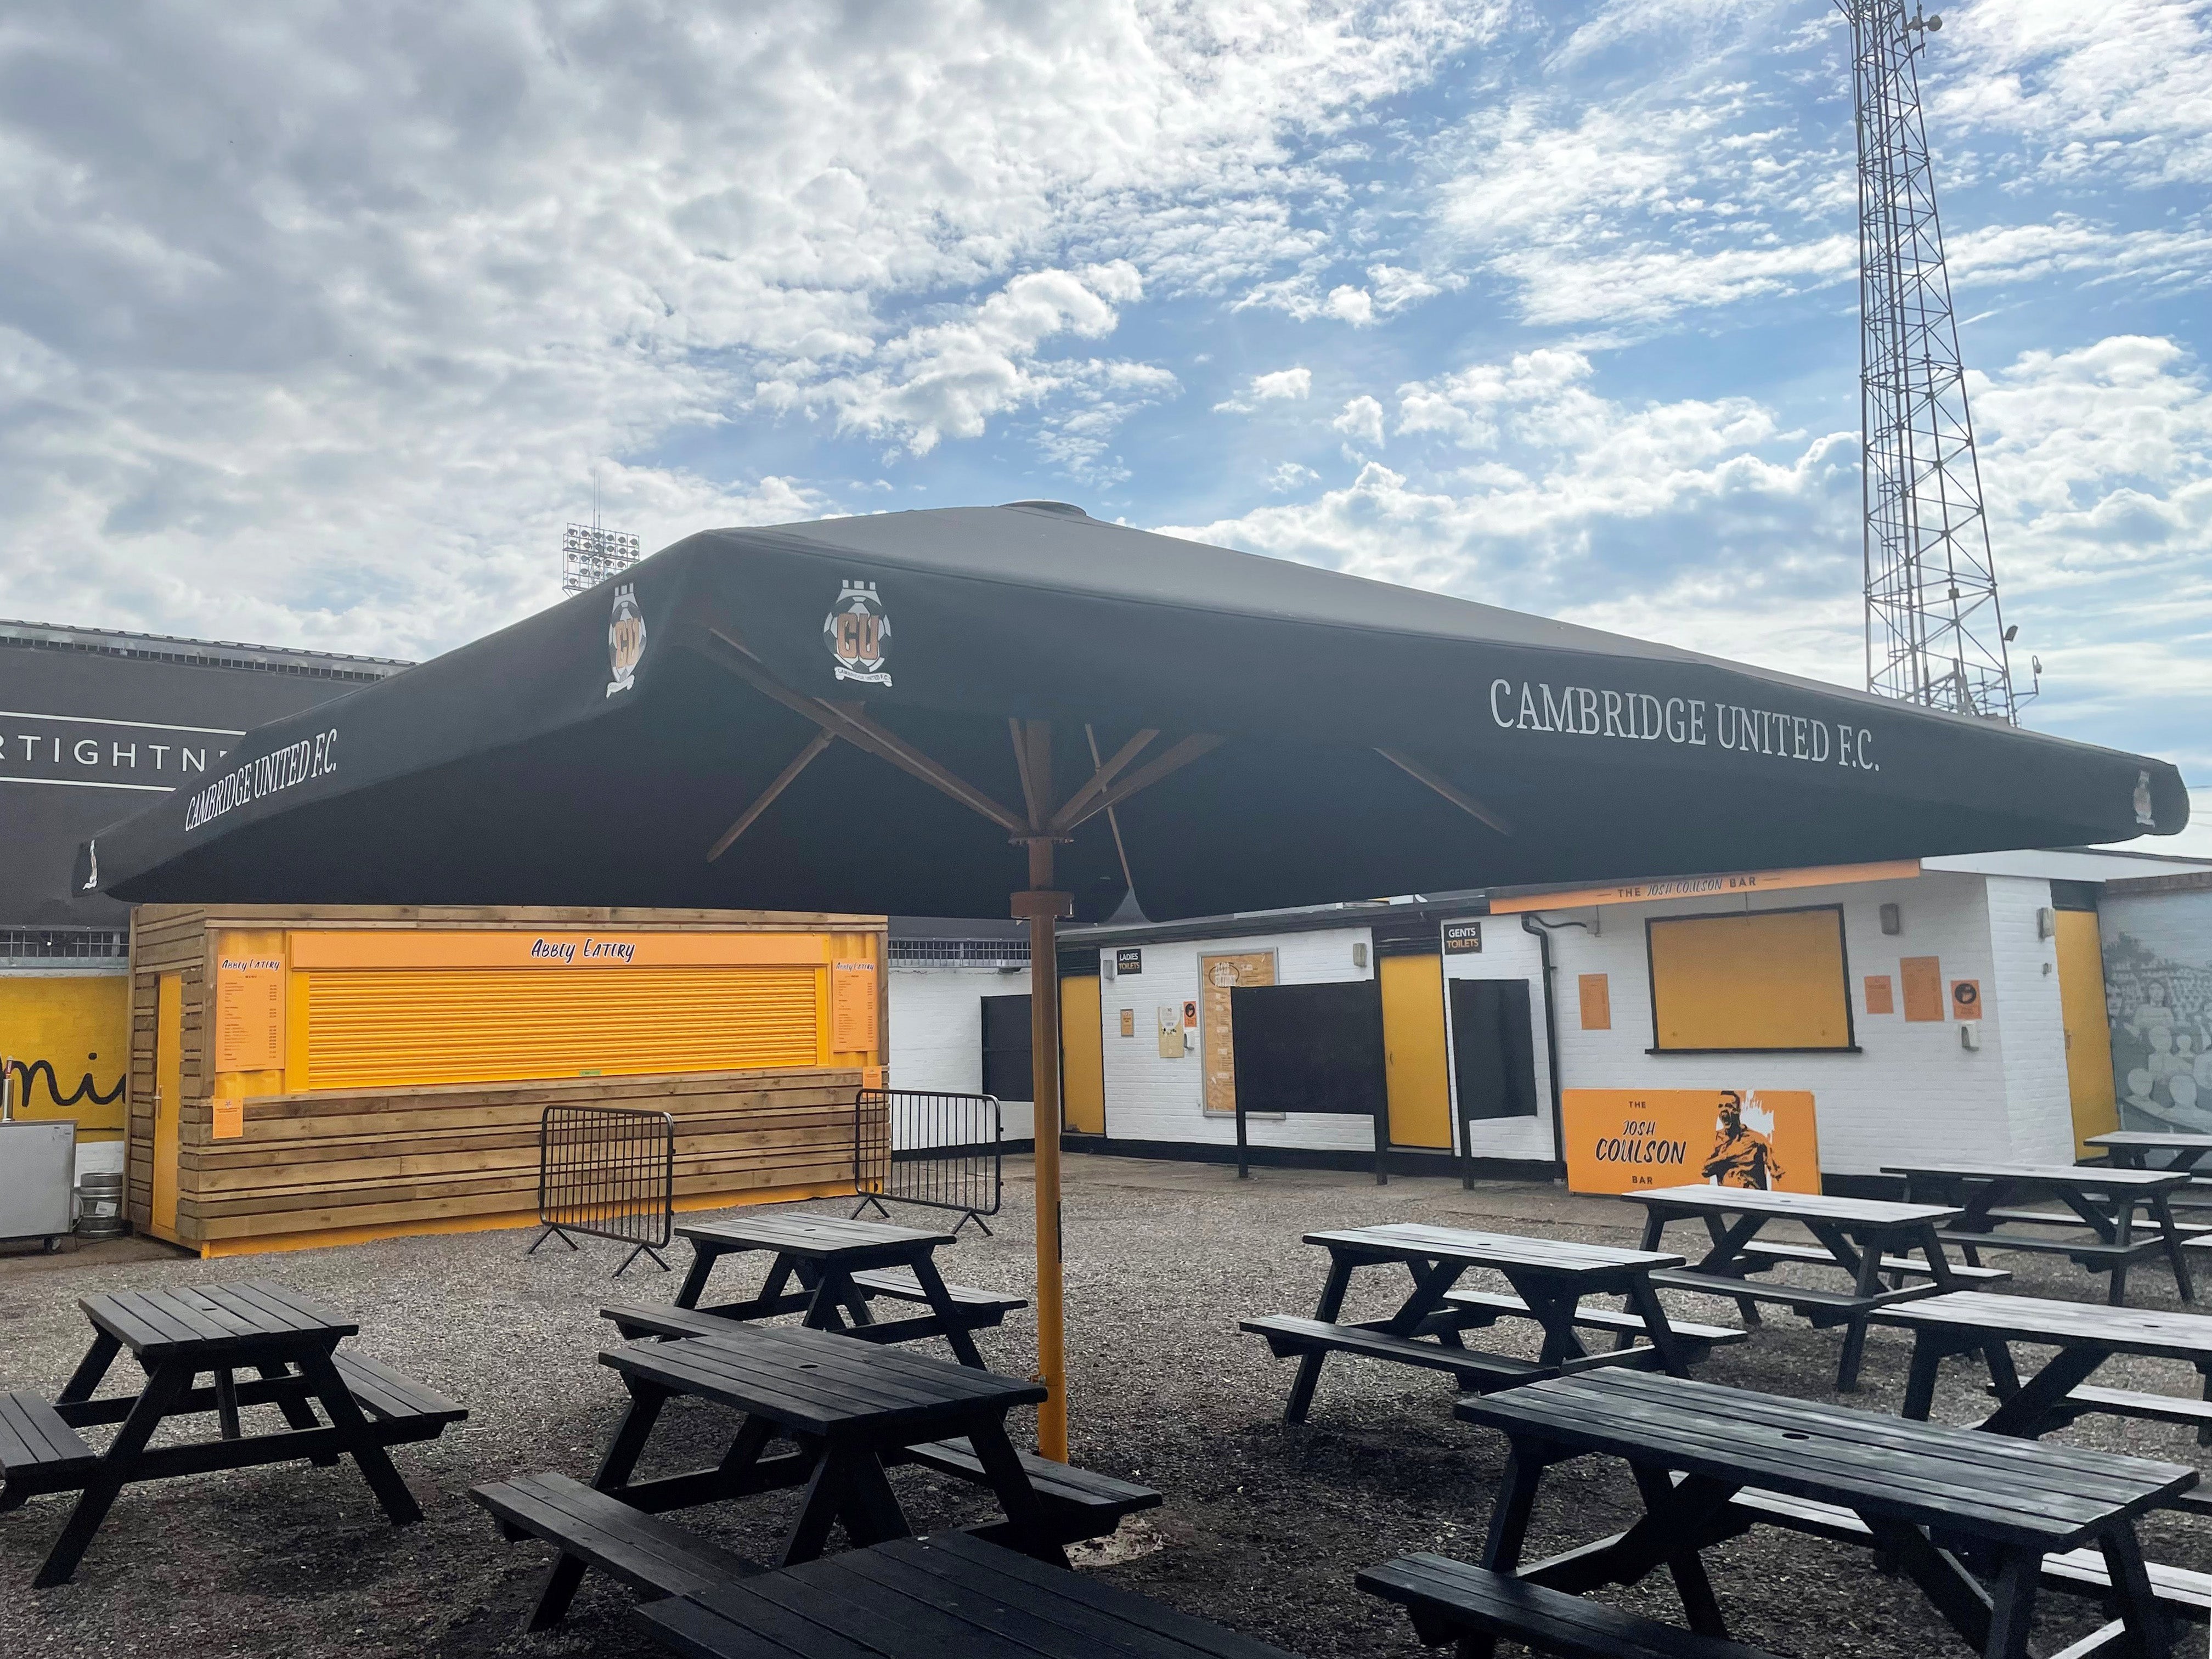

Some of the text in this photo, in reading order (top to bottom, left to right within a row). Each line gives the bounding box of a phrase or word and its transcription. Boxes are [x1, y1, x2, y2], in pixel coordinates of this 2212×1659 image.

[837, 613, 879, 661] CU
[1490, 679, 1880, 771] CAMBRIDGE UNITED F.C.
[185, 728, 337, 832] CAMBRIDGE UNITED F.C.
[1618, 877, 1756, 898] THE JOSH COULSON BAR
[1448, 927, 1476, 938] GENTS
[1446, 938, 1479, 949] TOILETS
[1120, 953, 1138, 961] LADIES
[1118, 962, 1140, 970] TOILETS
[1622, 1120, 1656, 1136] JOSH
[1595, 1138, 1686, 1165] COULSON
[1632, 1175, 1653, 1184] BAR
